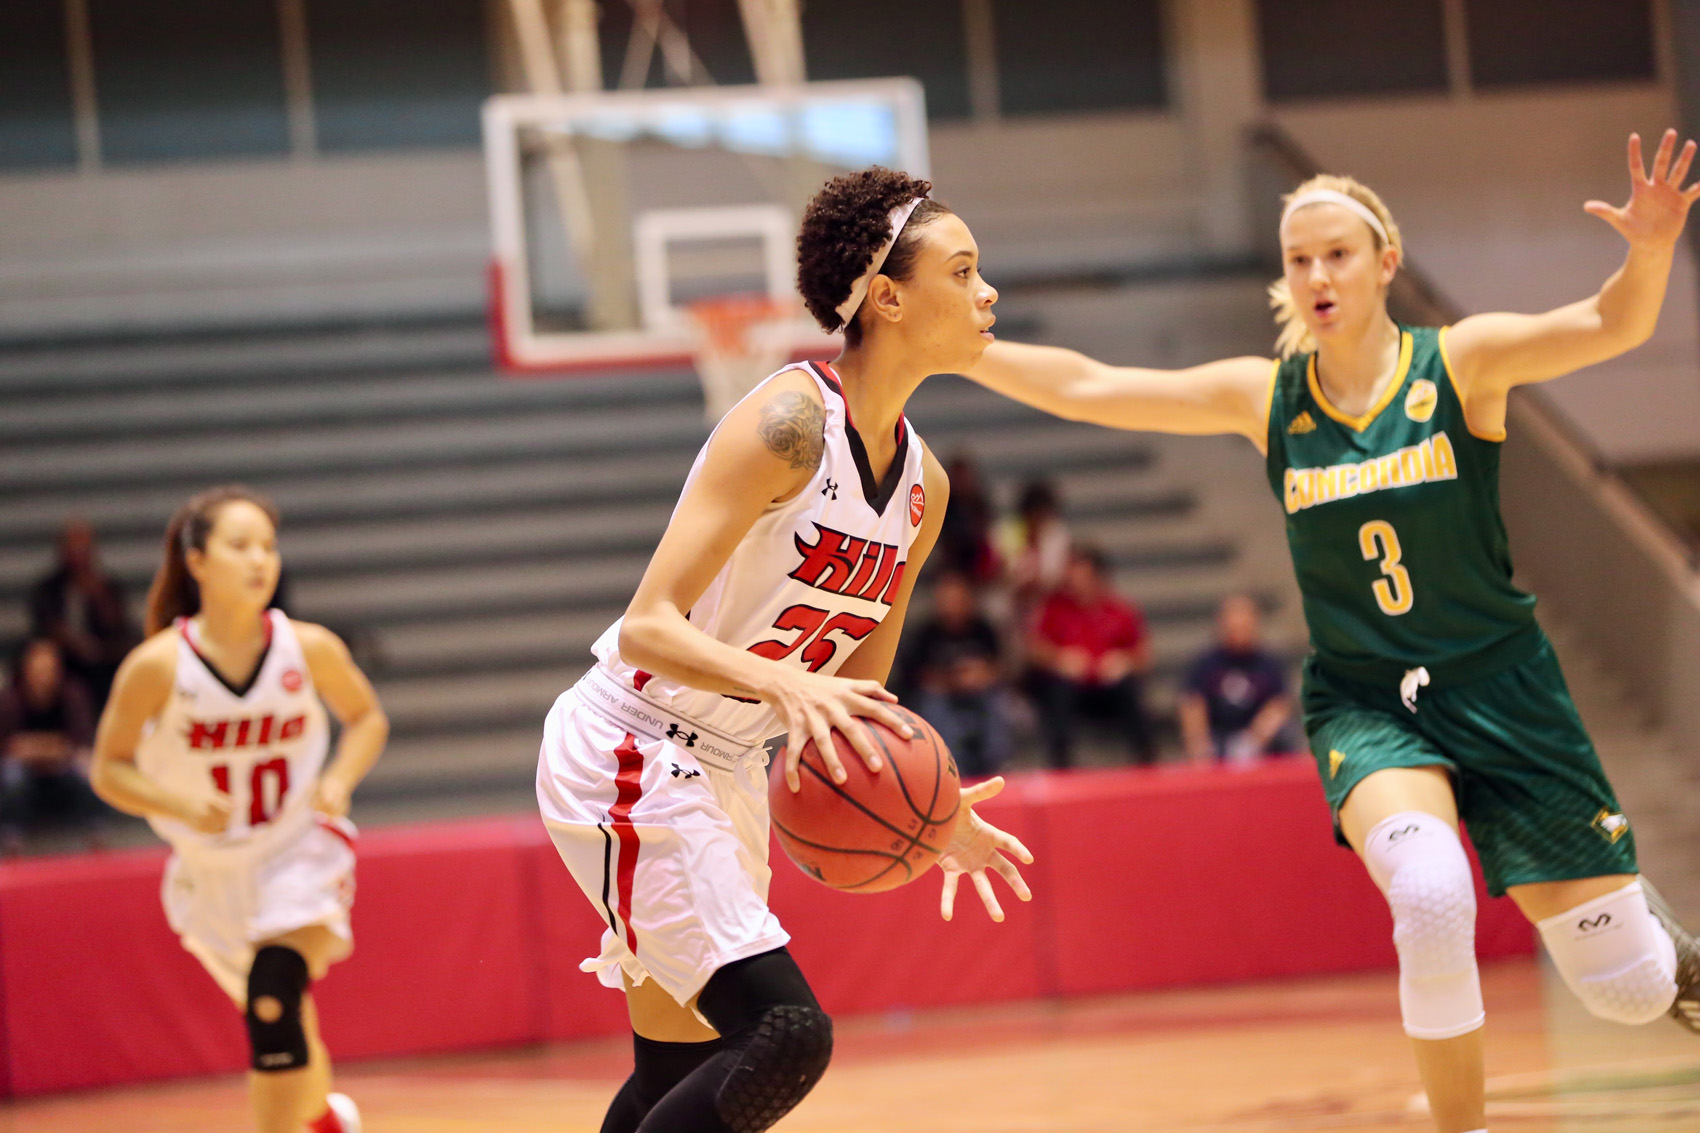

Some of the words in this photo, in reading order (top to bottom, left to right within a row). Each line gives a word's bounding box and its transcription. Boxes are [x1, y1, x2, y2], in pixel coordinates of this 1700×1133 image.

[1284, 431, 1458, 514] CONCORDIA
[1358, 519, 1414, 616] 3
[620, 702, 664, 730] UNDER
